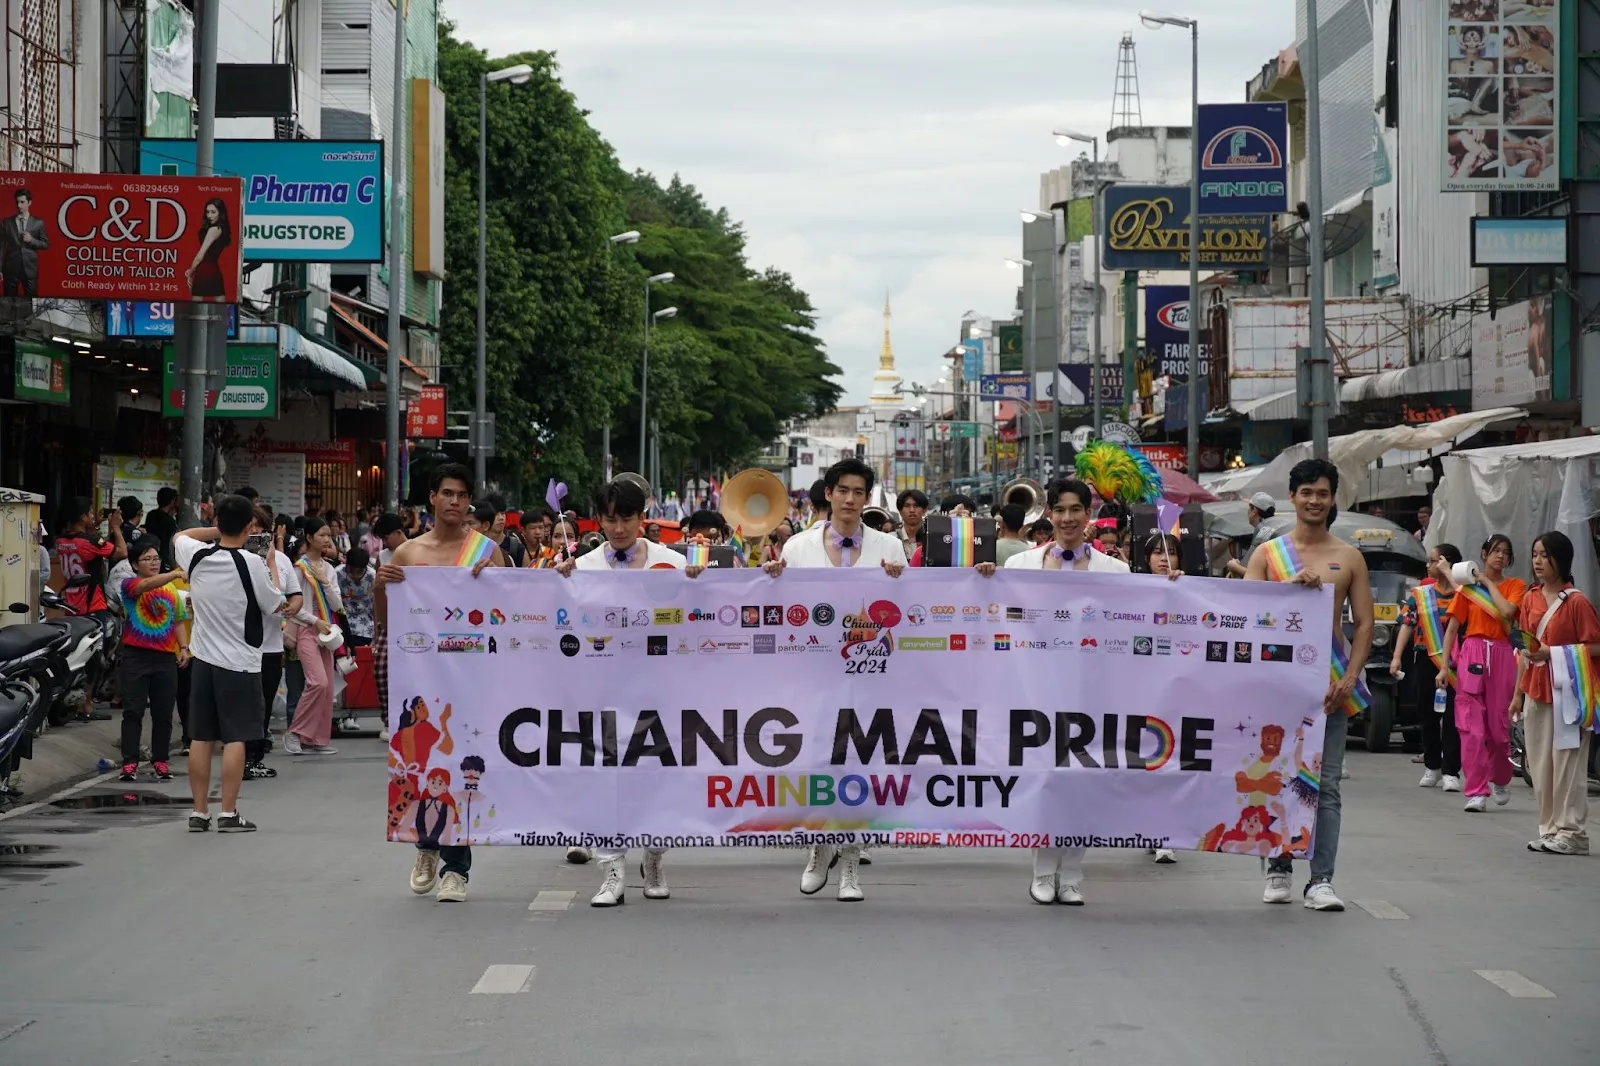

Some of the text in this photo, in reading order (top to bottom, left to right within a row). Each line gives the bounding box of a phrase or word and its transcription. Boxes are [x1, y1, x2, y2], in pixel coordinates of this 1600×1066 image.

[0, 177, 26, 186] 144/3
[1467, 183, 1496, 191] everyday
[123, 184, 179, 193] 0638294659
[248, 174, 376, 204] Pharma C
[1201, 181, 1284, 197] FINDIG
[57, 195, 187, 243] C&D
[1109, 197, 1267, 250] PAVIION
[66, 246, 178, 263] COLLECTION
[67, 264, 175, 278] CUSTOM TAILOR
[62, 280, 178, 292] Cloth Ready Within 12 Hrs
[1164, 344, 1213, 359] FAIREX
[226, 361, 270, 378] harma C
[222, 392, 265, 404] DRUGSTORE
[421, 391, 444, 400] sage
[1061, 430, 1084, 441] Hard
[297, 441, 350, 452] MASSAGE
[1144, 449, 1169, 460] ittle
[931, 606, 955, 614] CRYA
[1379, 606, 1391, 615] 73
[522, 613, 547, 622] KNACK
[1113, 612, 1146, 621] CAREMAT
[842, 615, 884, 632] Chiang
[1220, 621, 1245, 629] PRIDE
[838, 631, 864, 642] Mai
[778, 644, 806, 653] pantip
[855, 643, 889, 656] Pride
[903, 640, 943, 648] anywheel
[845, 659, 887, 675] 2024
[499, 707, 1214, 771] CHIANG MAI PRIDE
[707, 774, 1019, 809] RAINBOW CITY
[861, 833, 889, 845] งาน
[895, 832, 941, 846] PRIDE
[947, 833, 1005, 848] MONTH
[1010, 833, 1050, 848] 2024
